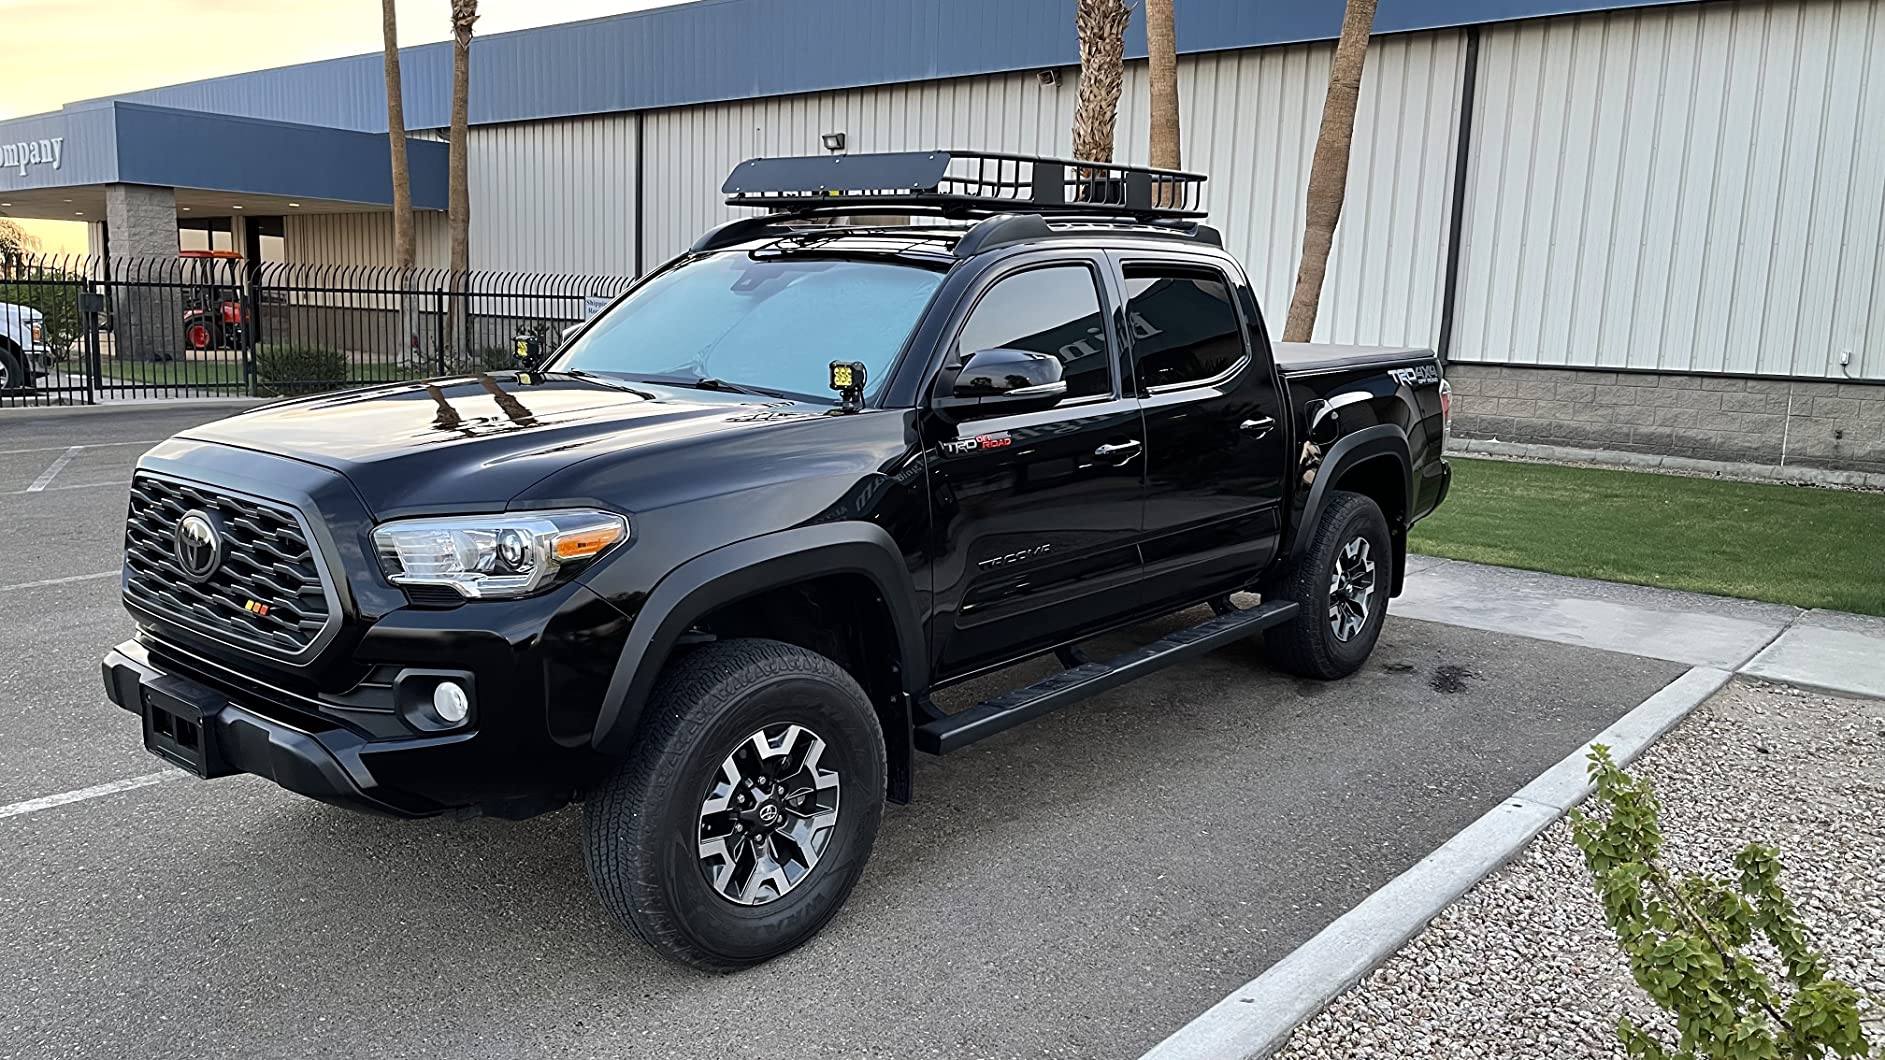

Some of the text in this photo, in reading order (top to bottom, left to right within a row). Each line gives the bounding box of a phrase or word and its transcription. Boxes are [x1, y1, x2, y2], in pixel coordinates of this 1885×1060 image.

[1387, 367, 1417, 386] TRD
[943, 438, 1012, 454] TRD ROAD
